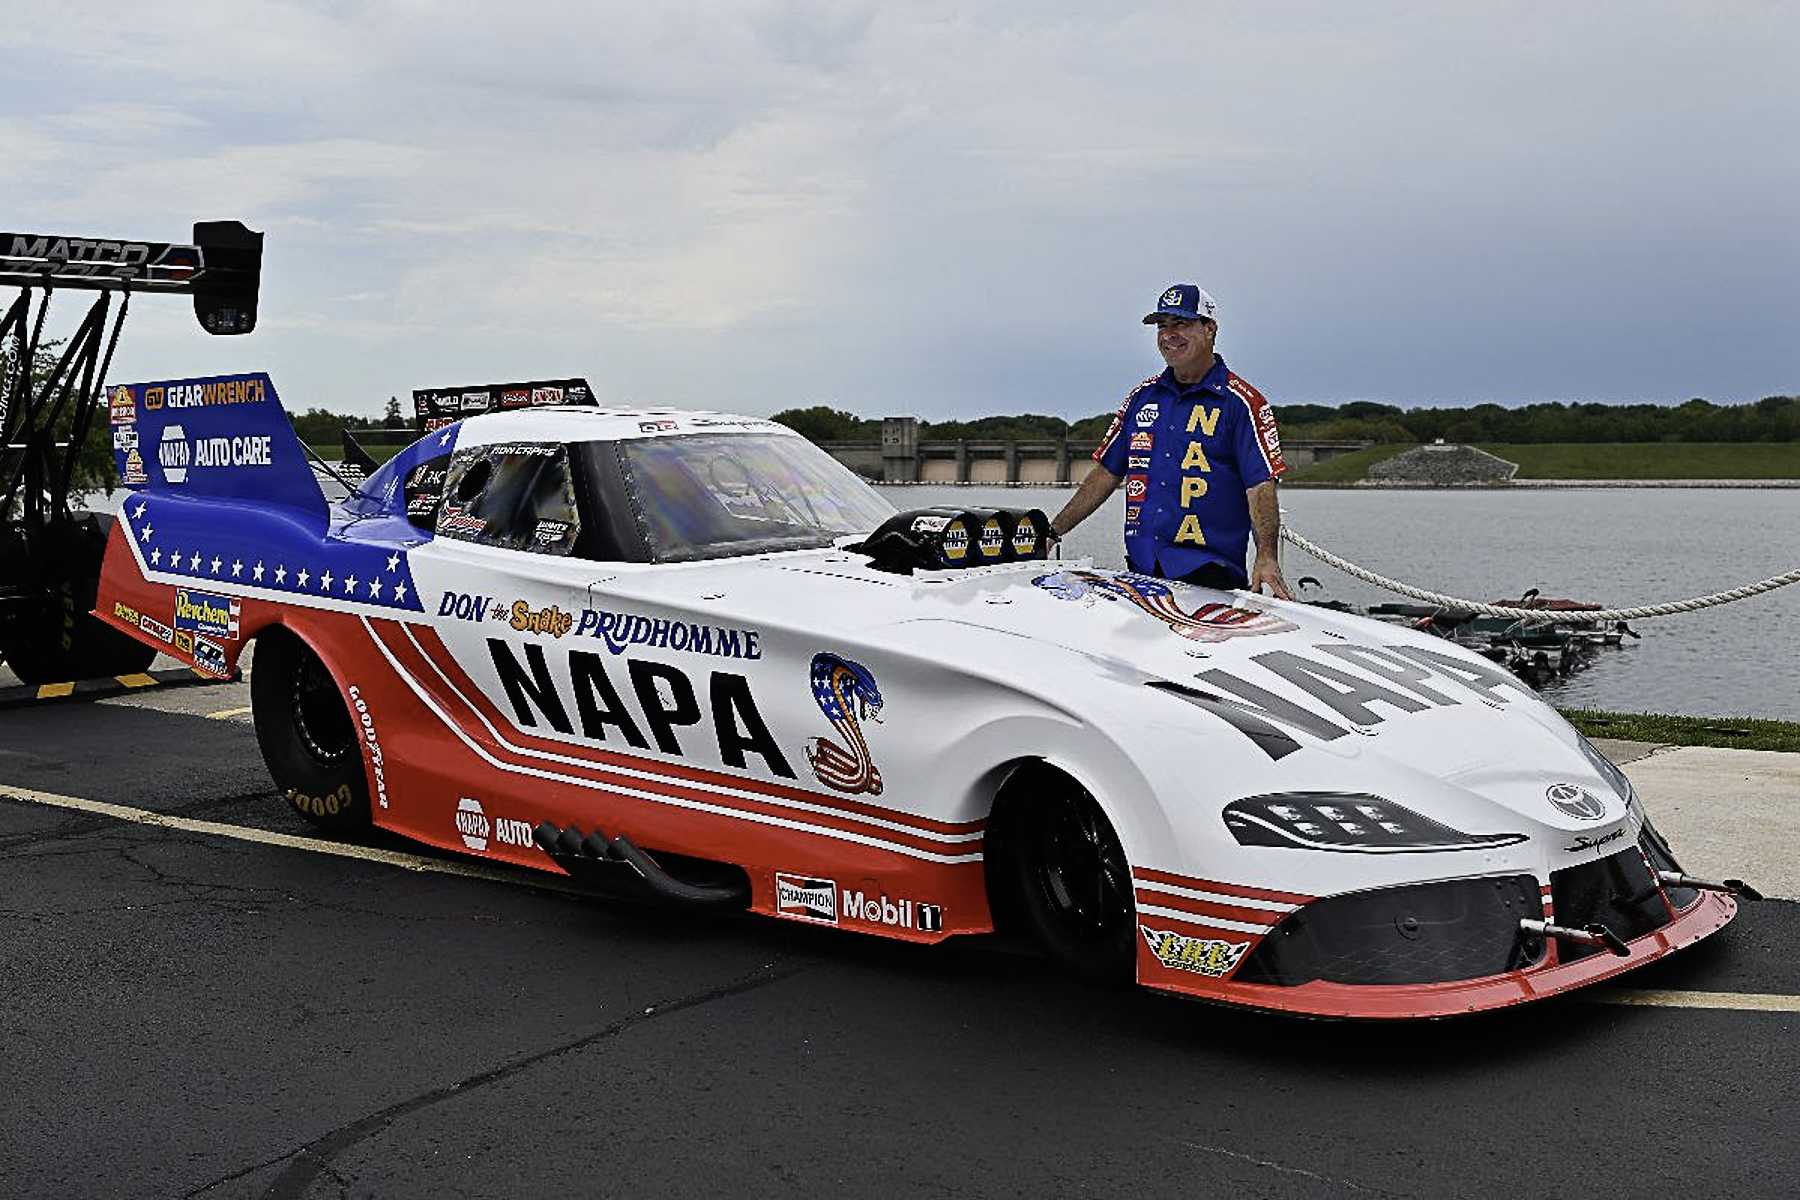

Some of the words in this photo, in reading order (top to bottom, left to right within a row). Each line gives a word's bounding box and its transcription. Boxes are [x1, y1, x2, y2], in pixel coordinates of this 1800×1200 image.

[9, 236, 149, 266] MATCO
[167, 380, 265, 408] GEARWRENCH
[194, 437, 231, 467] AUTO
[232, 436, 272, 465] CARE
[1174, 404, 1221, 546] NAPA
[440, 591, 493, 622] DON
[509, 600, 573, 639] Snake
[574, 608, 762, 660] PRUDHOMME
[486, 637, 798, 780] NAPA
[1146, 643, 1542, 762] NAPA
[349, 685, 389, 809] GOODYEAR
[496, 817, 534, 848] AUTO
[780, 887, 834, 909] CHAMPION
[842, 889, 912, 928] Mobil
[922, 906, 933, 929] 1
